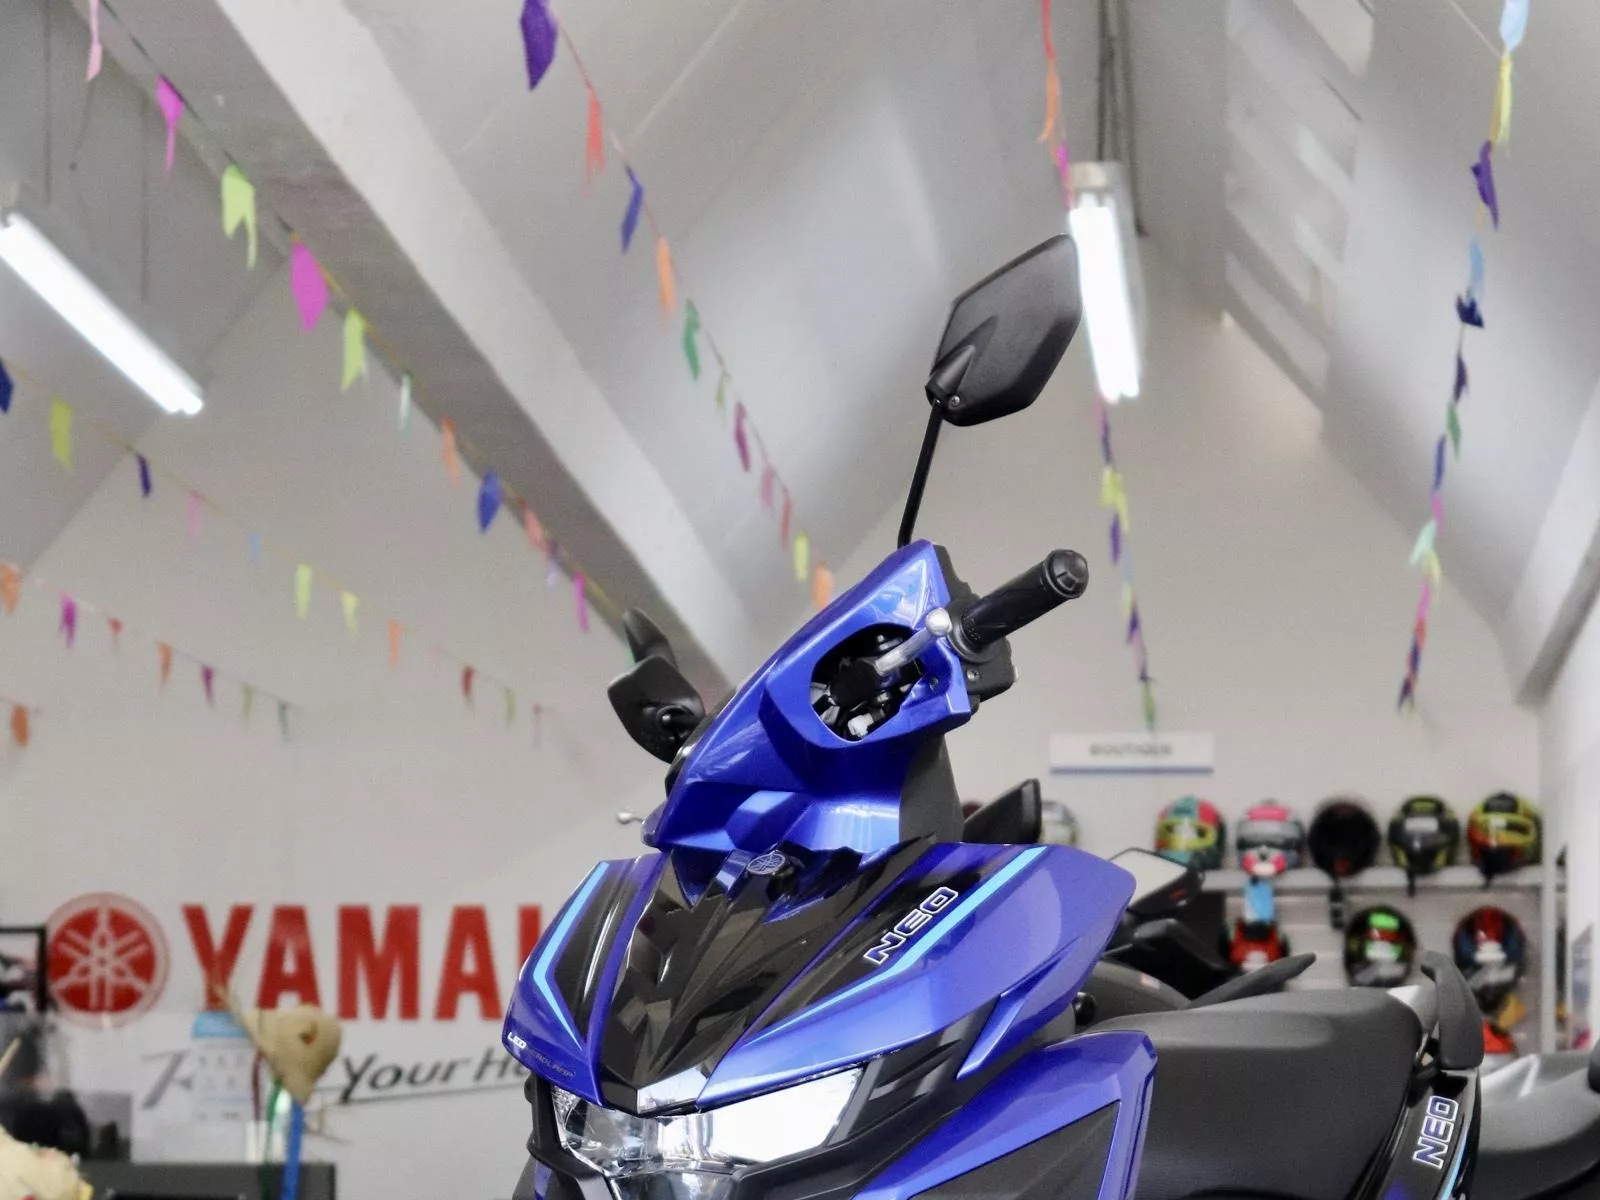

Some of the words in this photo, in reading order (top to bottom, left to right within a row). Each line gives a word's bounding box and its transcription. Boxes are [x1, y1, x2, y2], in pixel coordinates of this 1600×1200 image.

[863, 886, 959, 964] NEO
[507, 1031, 527, 1049] LED
[338, 1052, 473, 1105] Your
[1412, 1095, 1459, 1169] NEO
